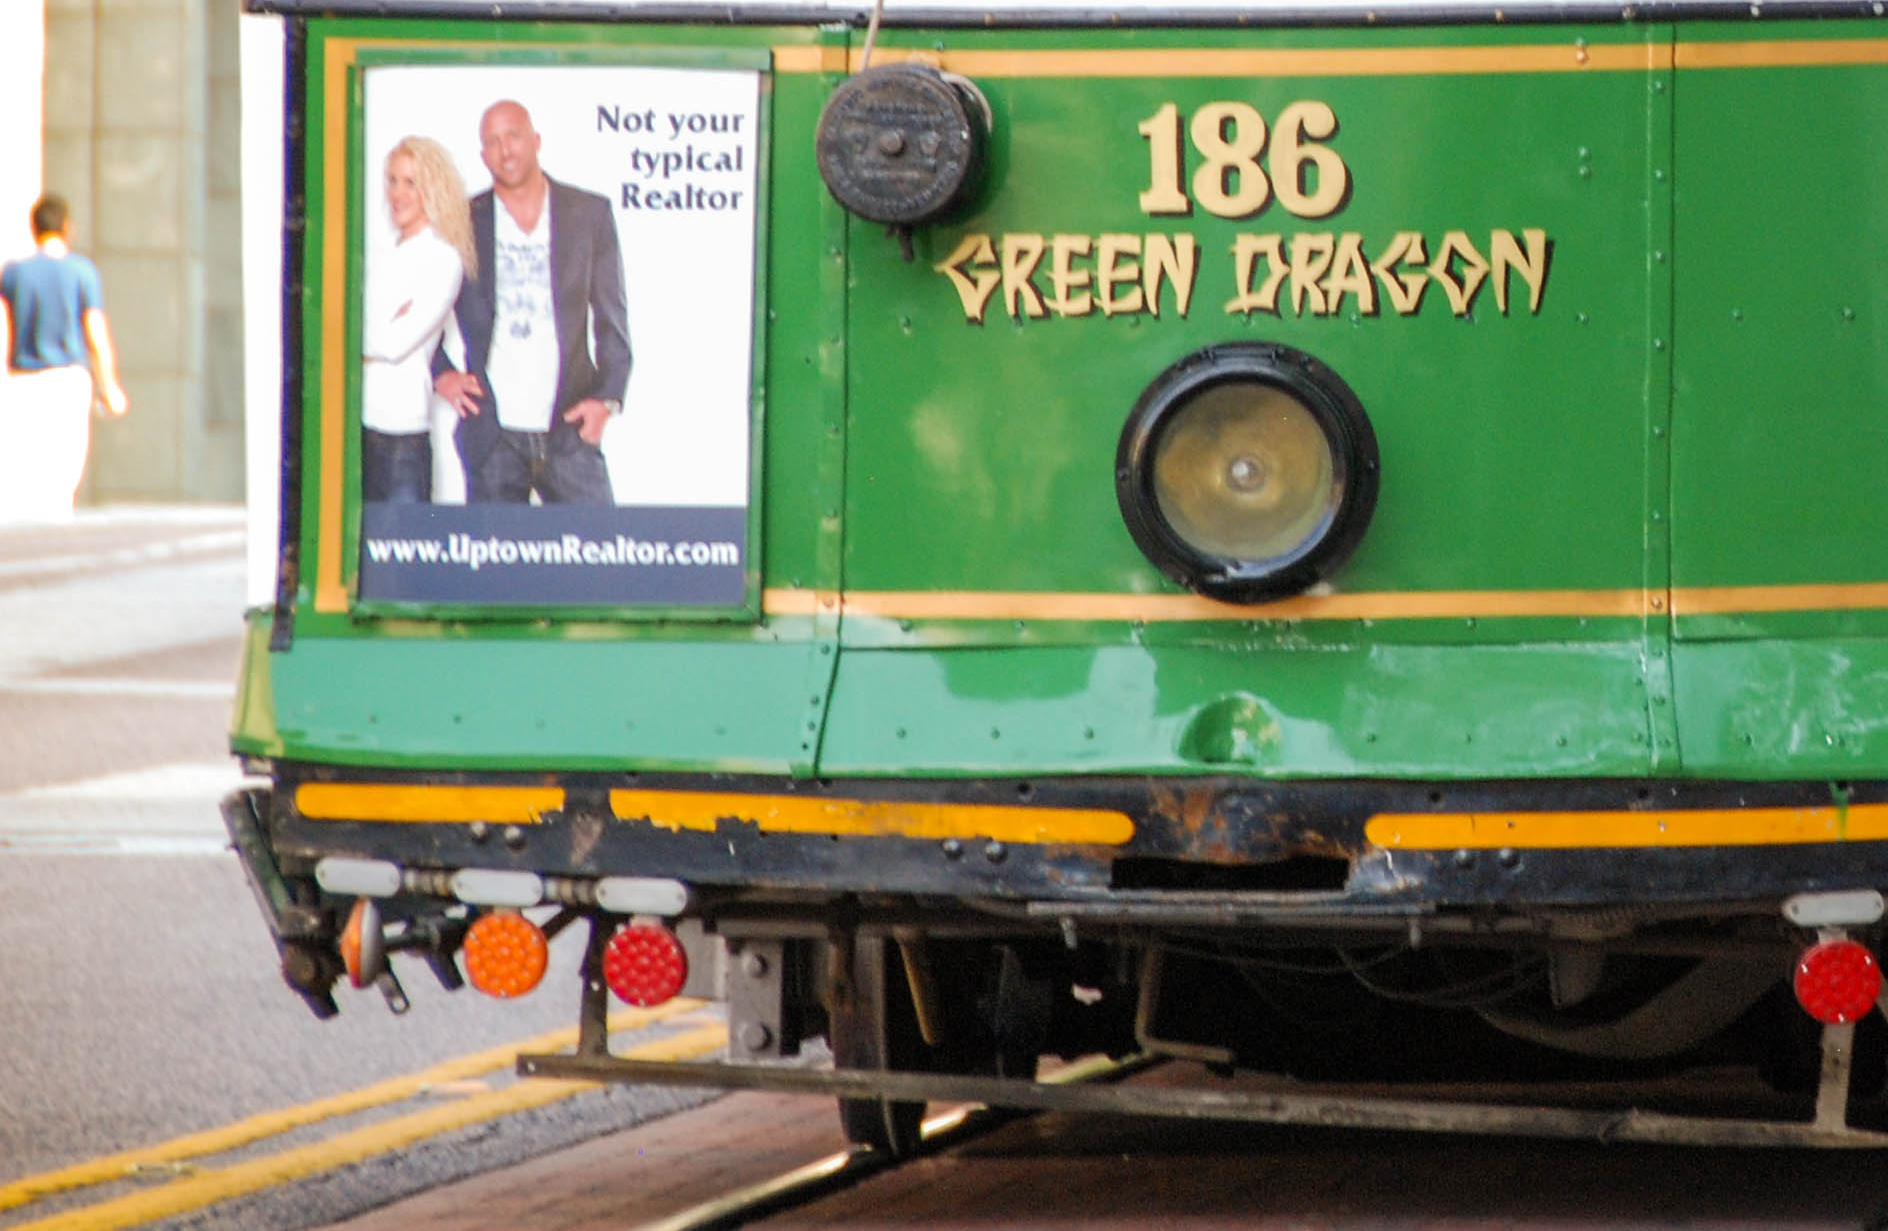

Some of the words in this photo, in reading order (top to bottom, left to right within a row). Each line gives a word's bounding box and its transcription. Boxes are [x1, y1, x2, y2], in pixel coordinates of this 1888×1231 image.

[597, 105, 656, 133] Not
[668, 111, 745, 140] your
[631, 146, 744, 179] typical
[1138, 100, 1350, 219] 186
[621, 183, 743, 210] Realtor
[936, 232, 1199, 322] GREEN
[1225, 229, 1550, 317] DRAGON
[366, 533, 740, 569] www.UptownRealtor.com
